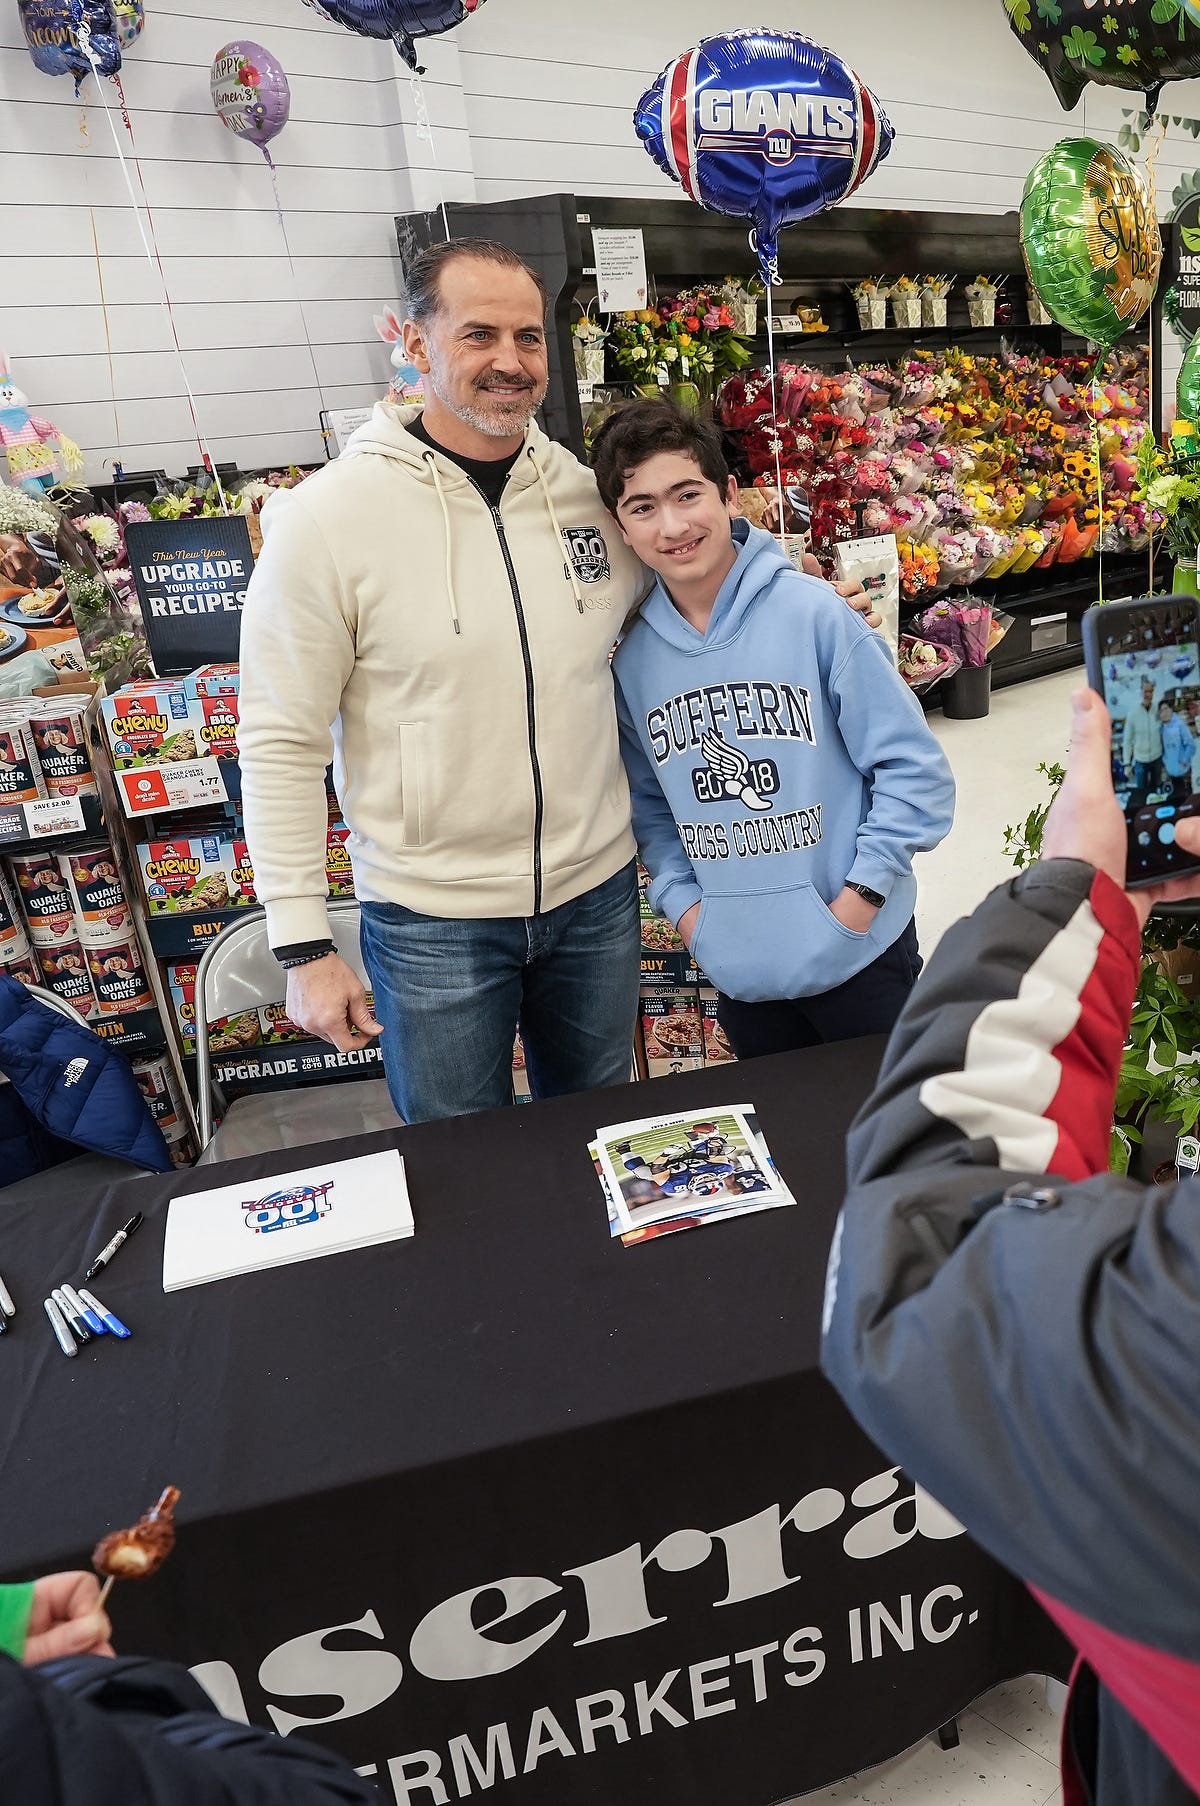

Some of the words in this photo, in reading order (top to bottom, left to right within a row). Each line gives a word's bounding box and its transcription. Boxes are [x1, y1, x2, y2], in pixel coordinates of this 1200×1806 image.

[211, 57, 240, 80] HAPPY
[700, 89, 854, 139] GIANTS
[226, 113, 246, 132] DAY
[152, 551, 174, 562] This
[175, 549, 199, 560] New
[200, 548, 227, 559] Year
[140, 559, 245, 584] UPGRADE
[164, 582, 194, 593] YOUR
[195, 580, 226, 591] GO-TO
[148, 590, 247, 617] RECIPES
[209, 715, 236, 726] BIG
[645, 680, 818, 767] SUFFERN
[50, 765, 77, 776] OATS
[162, 771, 183, 779] QUAKER
[199, 777, 219, 786] 1.77
[750, 762, 775, 793] 18
[33, 803, 50, 811] SAVE
[52, 800, 71, 808] $2.00
[732, 803, 823, 858] COUNTRY
[41, 902, 68, 914] OATS
[98, 895, 122, 908] OATS
[53, 975, 89, 992] QUAKE
[64, 985, 90, 997] OATS
[110, 988, 136, 1000] OATS
[654, 988, 680, 996] QUAKER
[301, 1056, 321, 1064] YOUR
[324, 1047, 384, 1069] RECIPE
[302, 1062, 322, 1070] GO-TO
[849, 1584, 979, 1664] INC.
